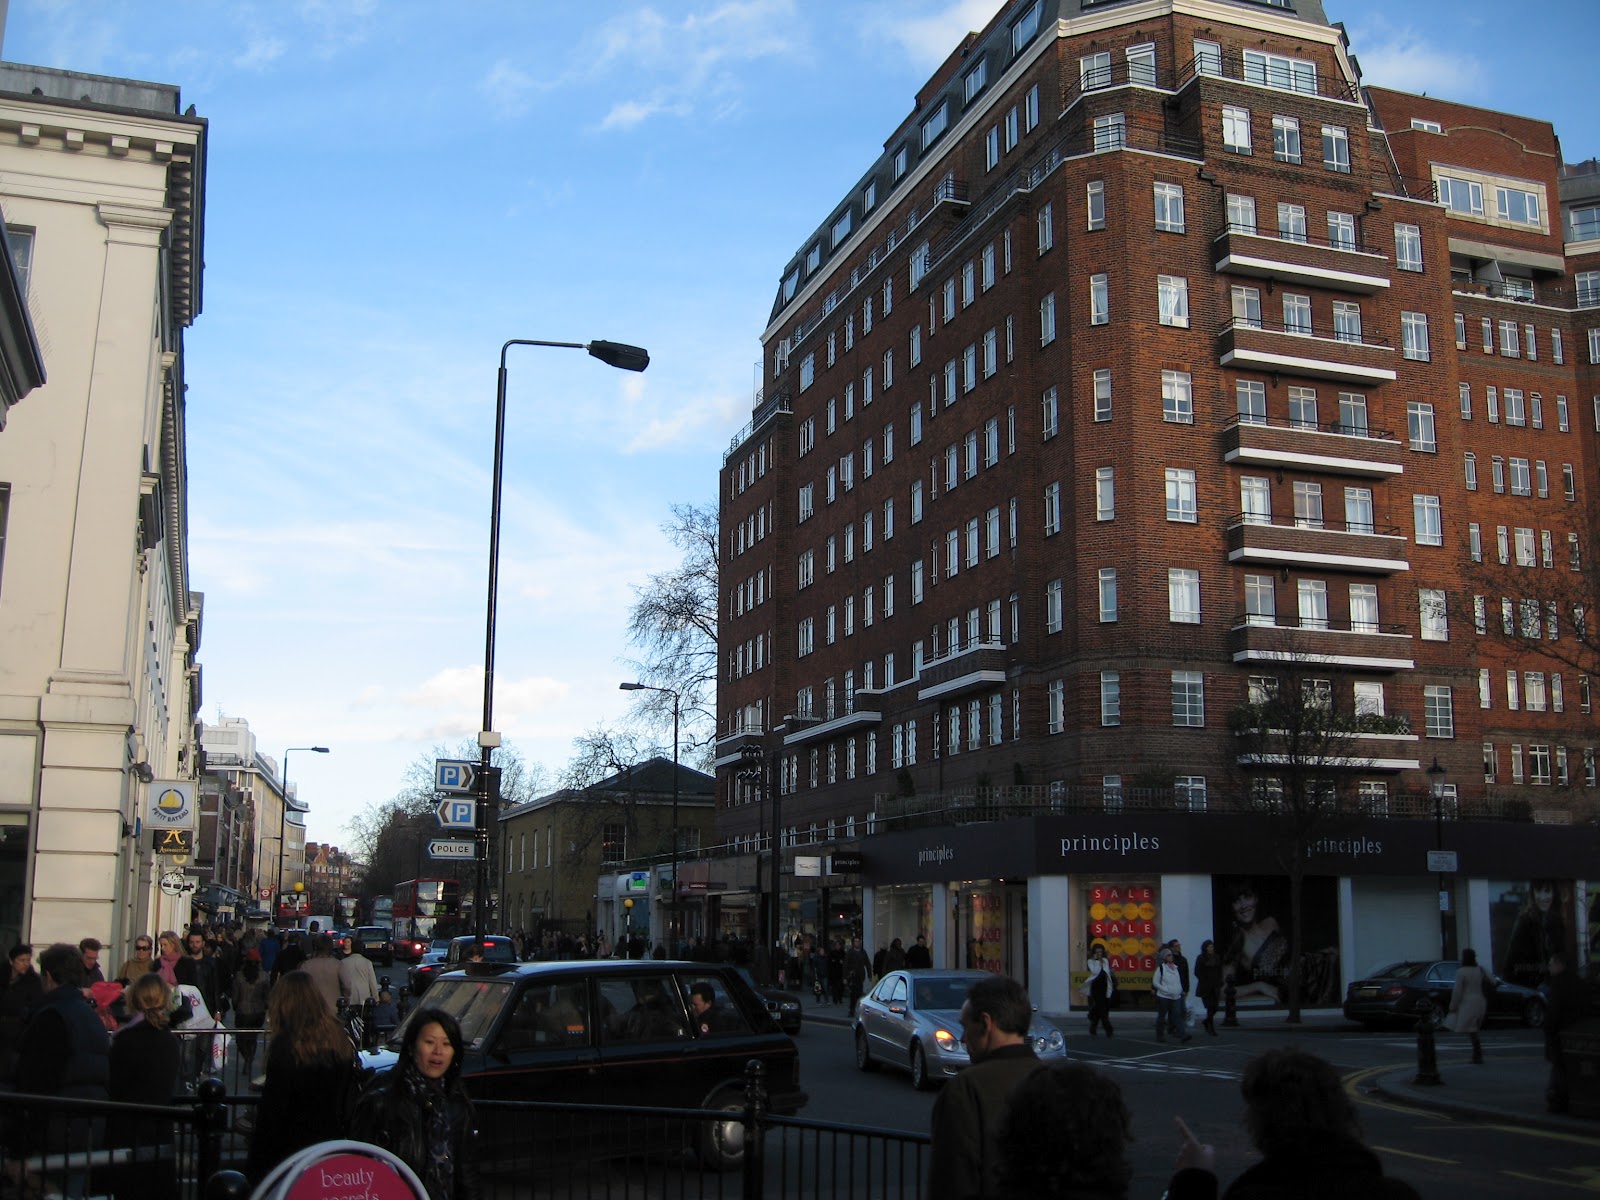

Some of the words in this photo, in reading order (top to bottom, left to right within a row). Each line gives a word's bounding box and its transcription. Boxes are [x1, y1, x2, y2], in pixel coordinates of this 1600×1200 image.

[444, 767, 457, 785] P
[152, 807, 166, 821] PETIT
[167, 809, 189, 822] BATEAU
[456, 804, 469, 821] P
[437, 845, 469, 853] POLICE
[1060, 832, 1160, 857] principles
[1306, 836, 1382, 859] principles
[918, 844, 954, 867] principles
[1095, 889, 1150, 898] SALE
[1095, 924, 1151, 933] SALE
[1111, 959, 1151, 969] ALE
[321, 1167, 374, 1190] beauty
